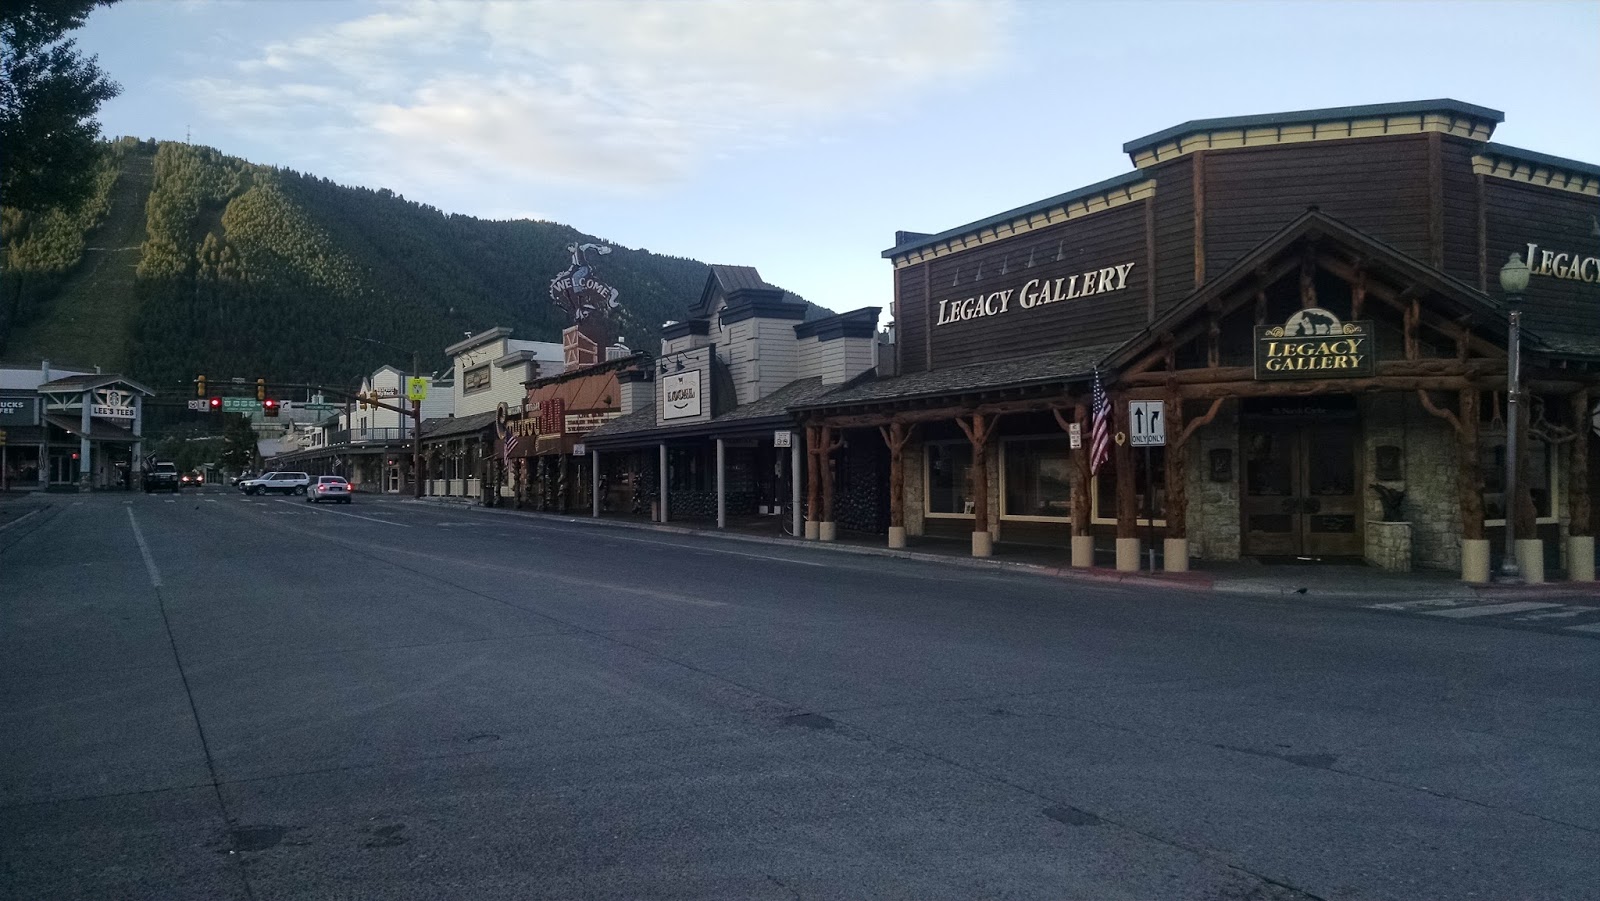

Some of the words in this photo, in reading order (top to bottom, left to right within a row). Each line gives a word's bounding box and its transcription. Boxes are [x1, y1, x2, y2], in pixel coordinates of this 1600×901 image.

[553, 278, 609, 298] WELCOME
[937, 289, 1014, 326] LEGACY
[1019, 262, 1134, 309] GALLERY
[1267, 338, 1364, 357] LEGACY
[1265, 355, 1364, 371] GALLERY
[667, 388, 696, 402] LOCAL
[94, 407, 114, 415] LEE'S
[116, 408, 134, 416] TEES
[1132, 435, 1147, 443] ONLY
[1148, 434, 1163, 443] ONLY
